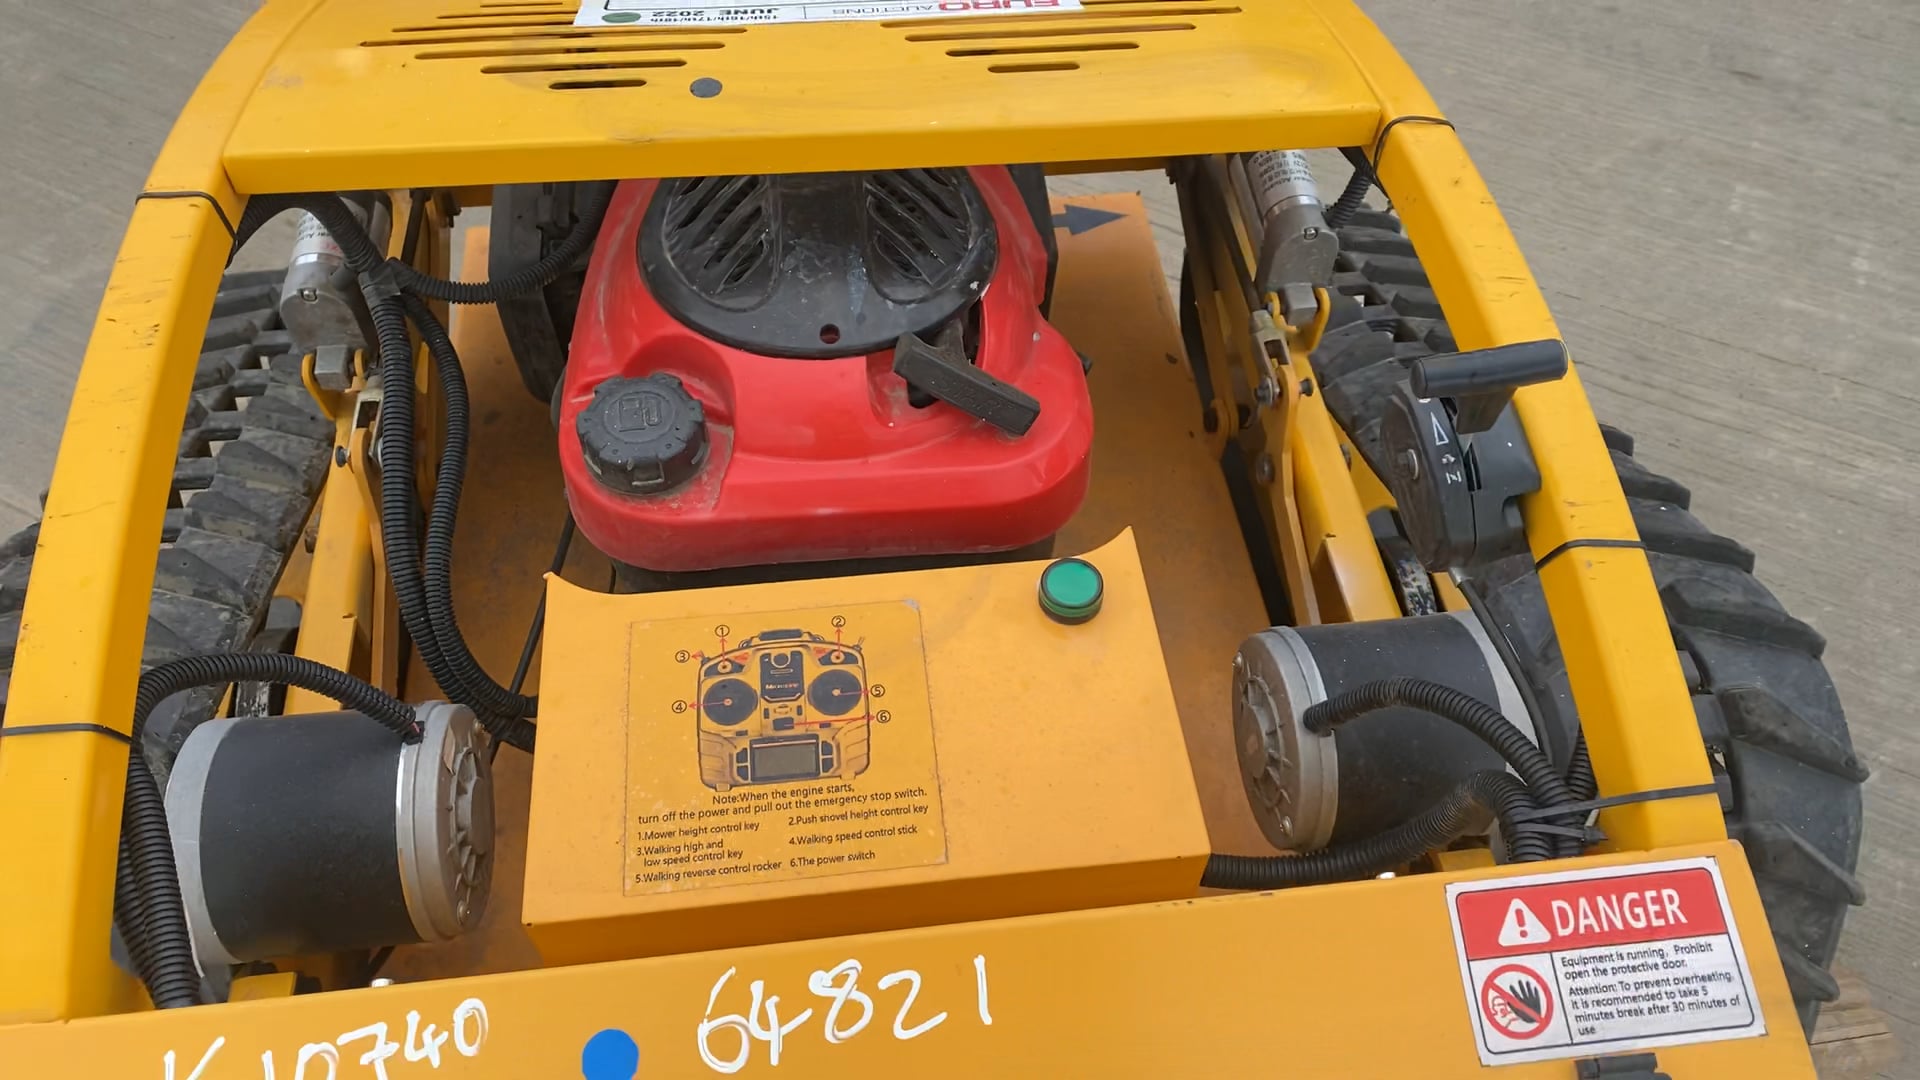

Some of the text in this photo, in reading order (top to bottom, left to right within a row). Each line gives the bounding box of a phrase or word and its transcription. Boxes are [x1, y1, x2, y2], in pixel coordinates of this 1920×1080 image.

[832, 4, 934, 15] AUCTIONS
[771, 789, 787, 799] the
[790, 785, 824, 798] engine
[638, 787, 927, 824] turn off the power and pull out the emergency stop switch.
[788, 814, 817, 826] 2.Push
[850, 807, 879, 821] height
[880, 804, 911, 816] control
[913, 804, 929, 815] key
[637, 821, 760, 841] 1.Mower height control key
[789, 824, 918, 846] 4.Walking speed control stick
[636, 839, 724, 857] 3.Walking high and
[643, 849, 744, 867] low speed control key
[790, 850, 876, 868] 6.The power switch
[635, 861, 783, 884] 5.Walking reverse control rocker
[1551, 888, 1688, 937] DANGER
[1561, 953, 1616, 968] Equipment
[1616, 951, 1625, 961] is
[1673, 941, 1714, 955] Prohibit
[1564, 968, 1590, 981] open
[1592, 966, 1608, 977] the
[1611, 961, 1660, 977] protective
[1569, 983, 1618, 996] Attention:
[1618, 980, 1631, 991] To
[1634, 977, 1672, 991] prevent
[1574, 994, 1741, 1023] minutes break after 30 minutes of
[1581, 998, 1589, 1009] is
[1591, 989, 1663, 1008] recommended
[1664, 990, 1676, 1000] to
[1678, 987, 1700, 999] take
[697, 954, 993, 1074] 64821
[1578, 1026, 1597, 1036] use
